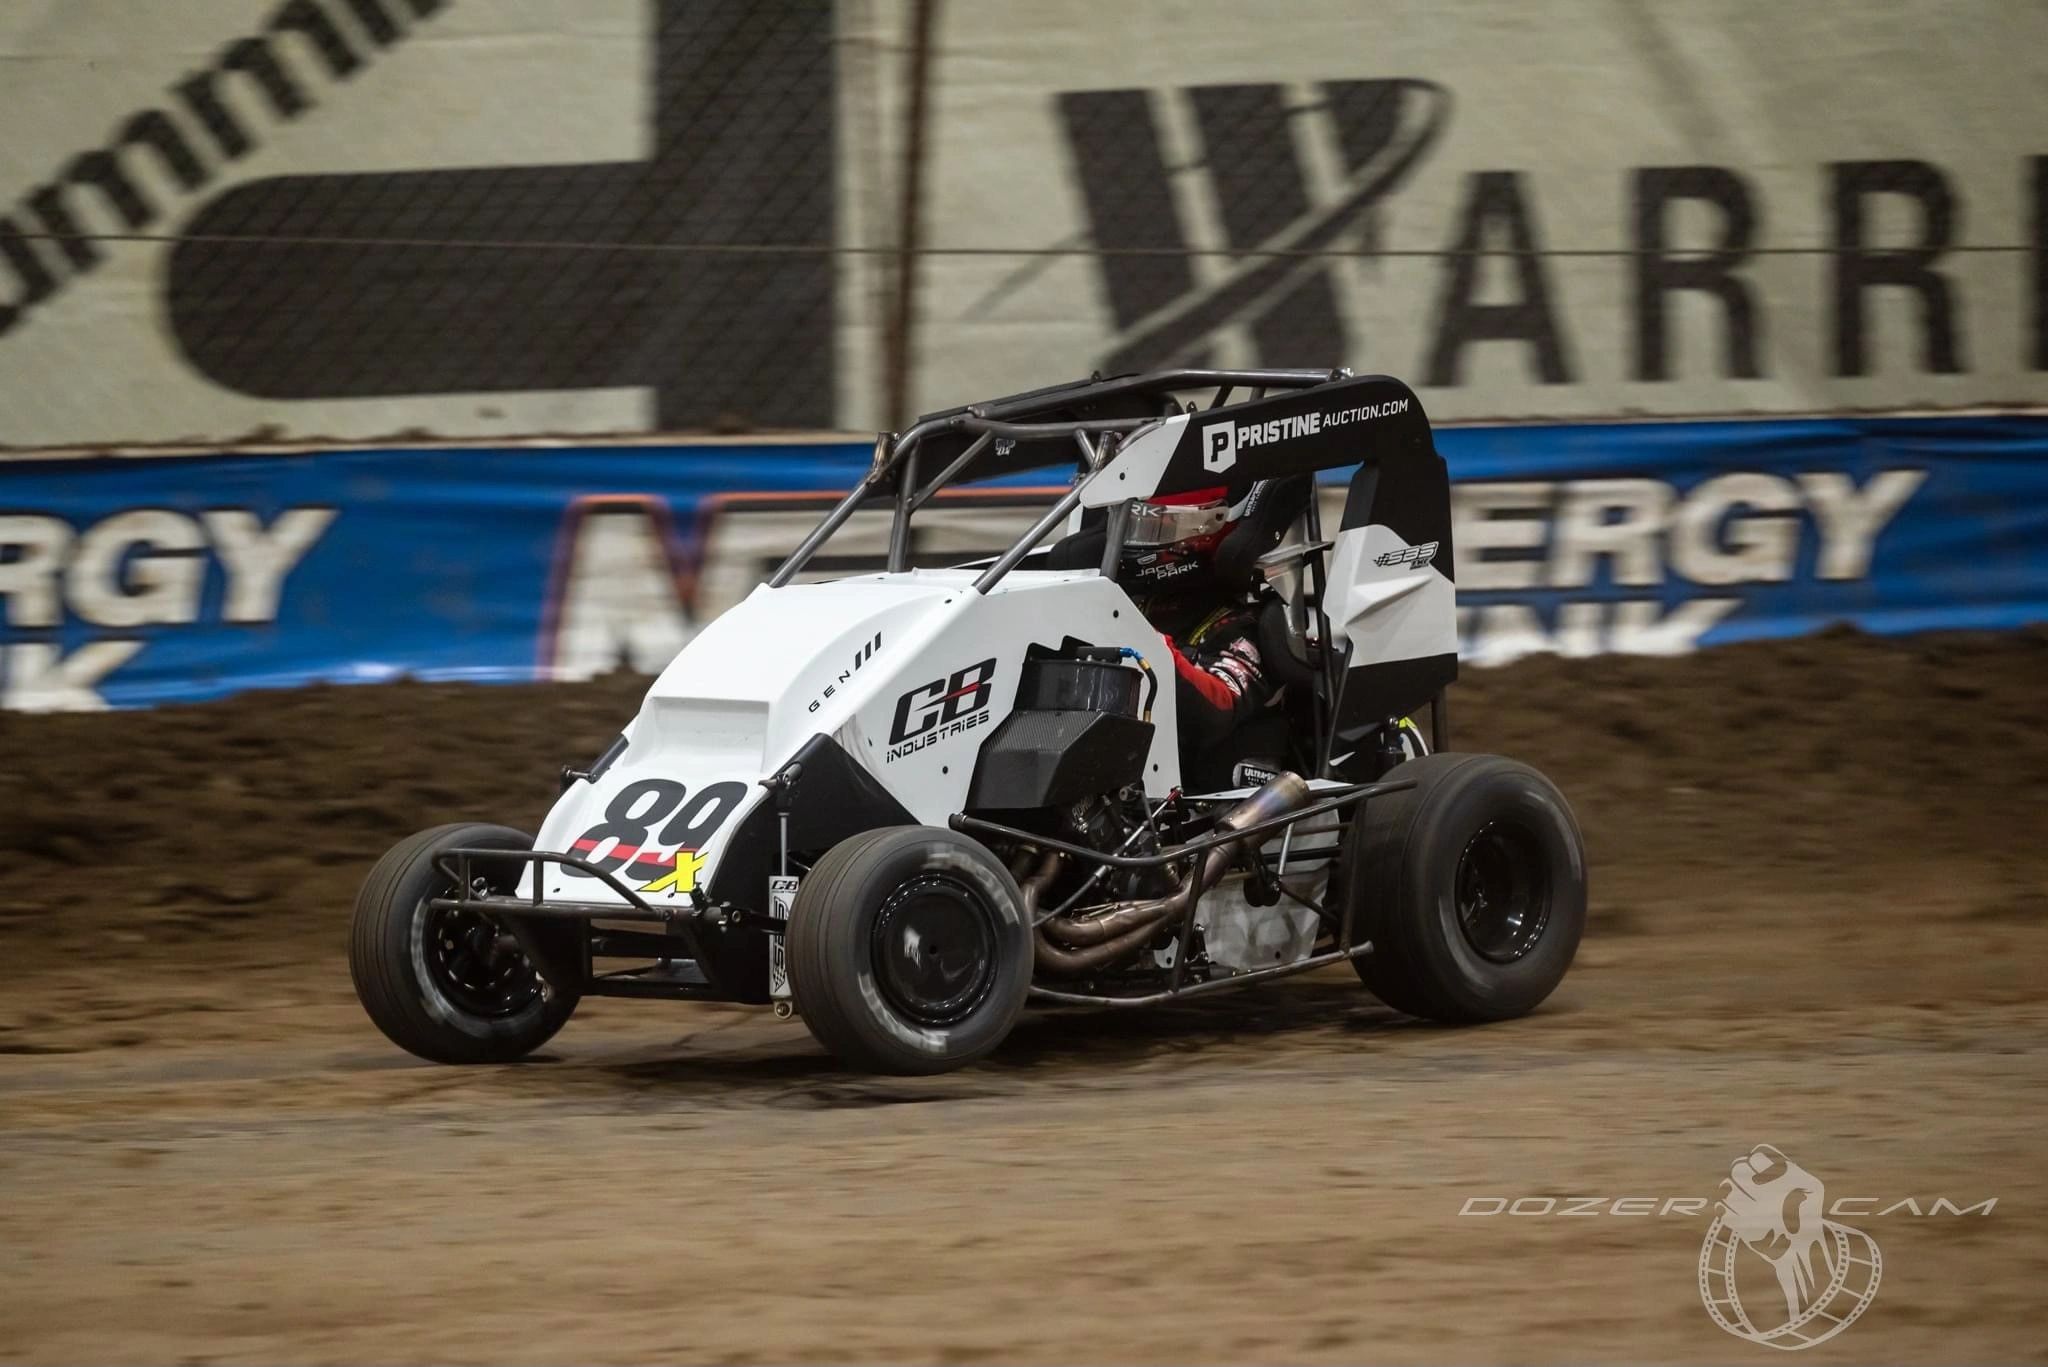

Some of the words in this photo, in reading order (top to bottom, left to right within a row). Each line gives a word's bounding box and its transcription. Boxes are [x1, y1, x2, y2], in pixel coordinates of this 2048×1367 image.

[1237, 411, 1321, 449] PRISTINE
[1323, 398, 1409, 428] AUCTION.COM
[1157, 561, 1199, 579] PARK
[809, 669, 850, 712] GEN
